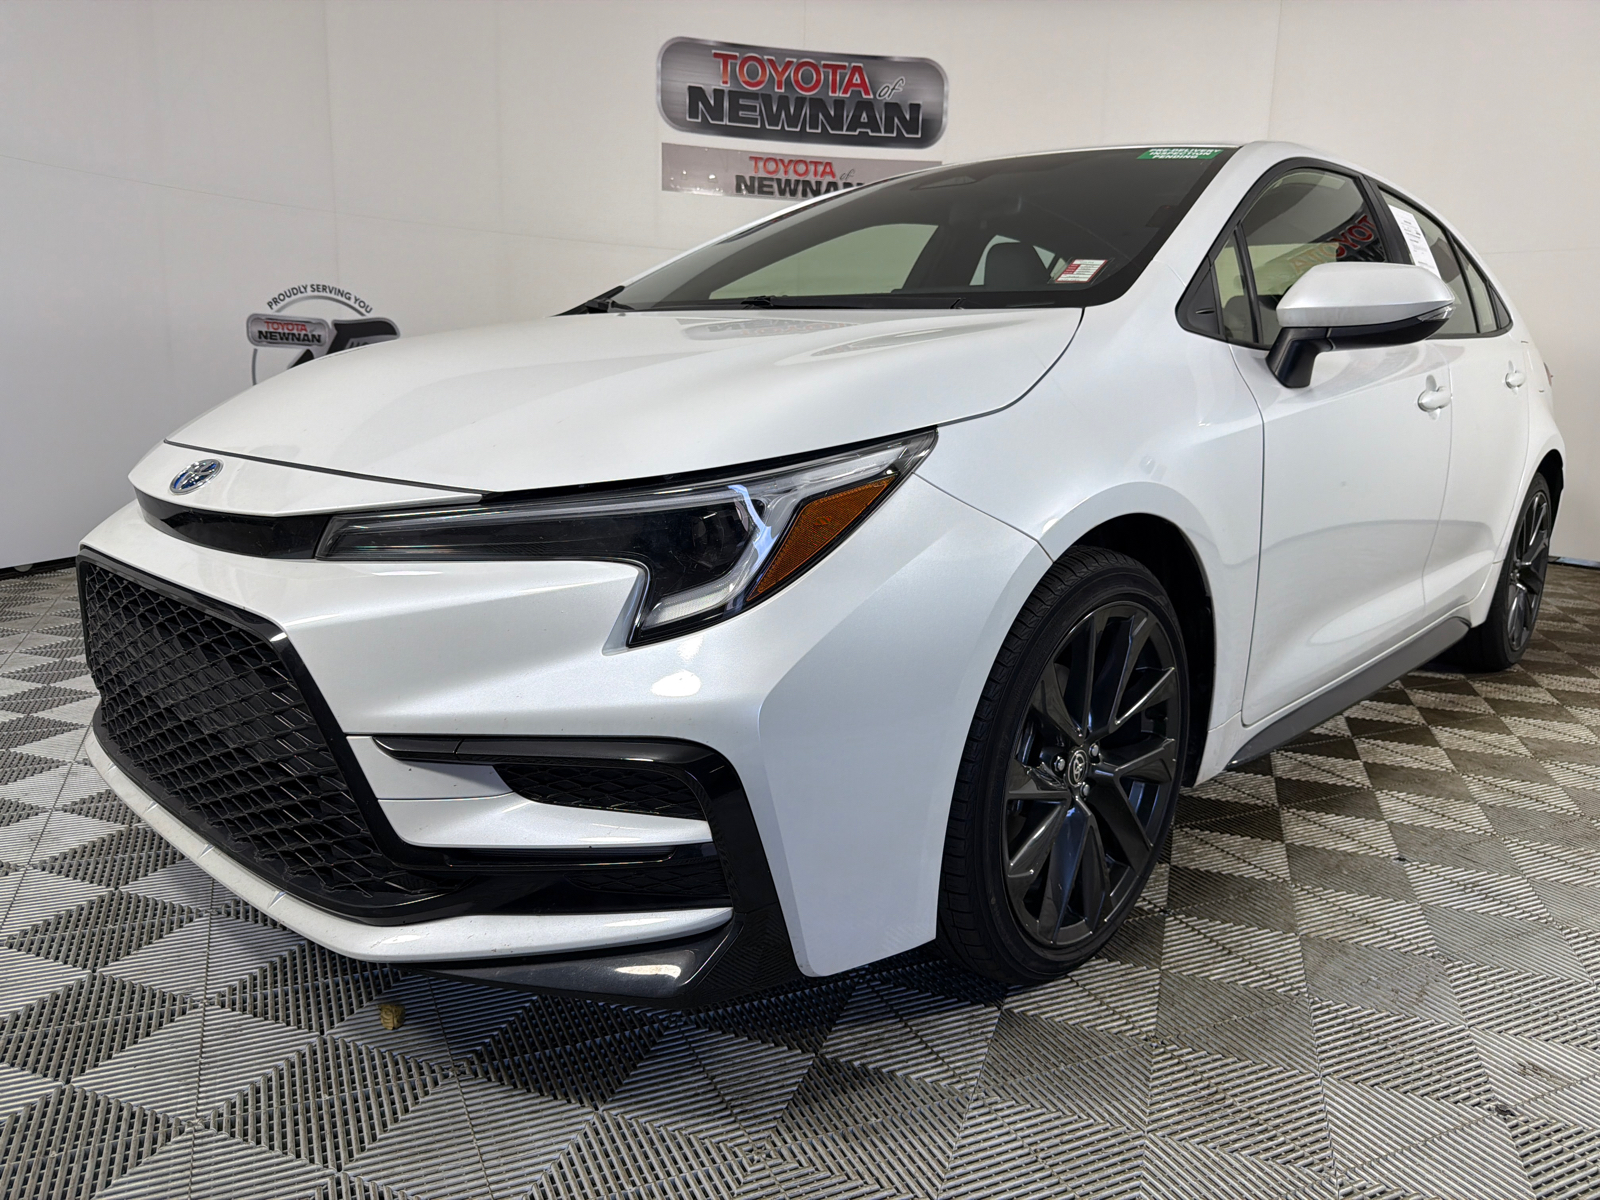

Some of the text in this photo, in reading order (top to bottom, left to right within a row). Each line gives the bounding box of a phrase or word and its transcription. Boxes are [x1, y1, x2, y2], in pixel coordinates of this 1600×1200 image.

[712, 50, 905, 100] TOYOTA of
[686, 85, 922, 138] NEWNAN
[749, 156, 855, 180] TOYOTA of
[735, 175, 865, 198] NEWNA
[267, 284, 373, 314] PROUDLY SERVING YOU
[258, 330, 322, 343] NEWNAN
[264, 320, 308, 332] TOYOTA
